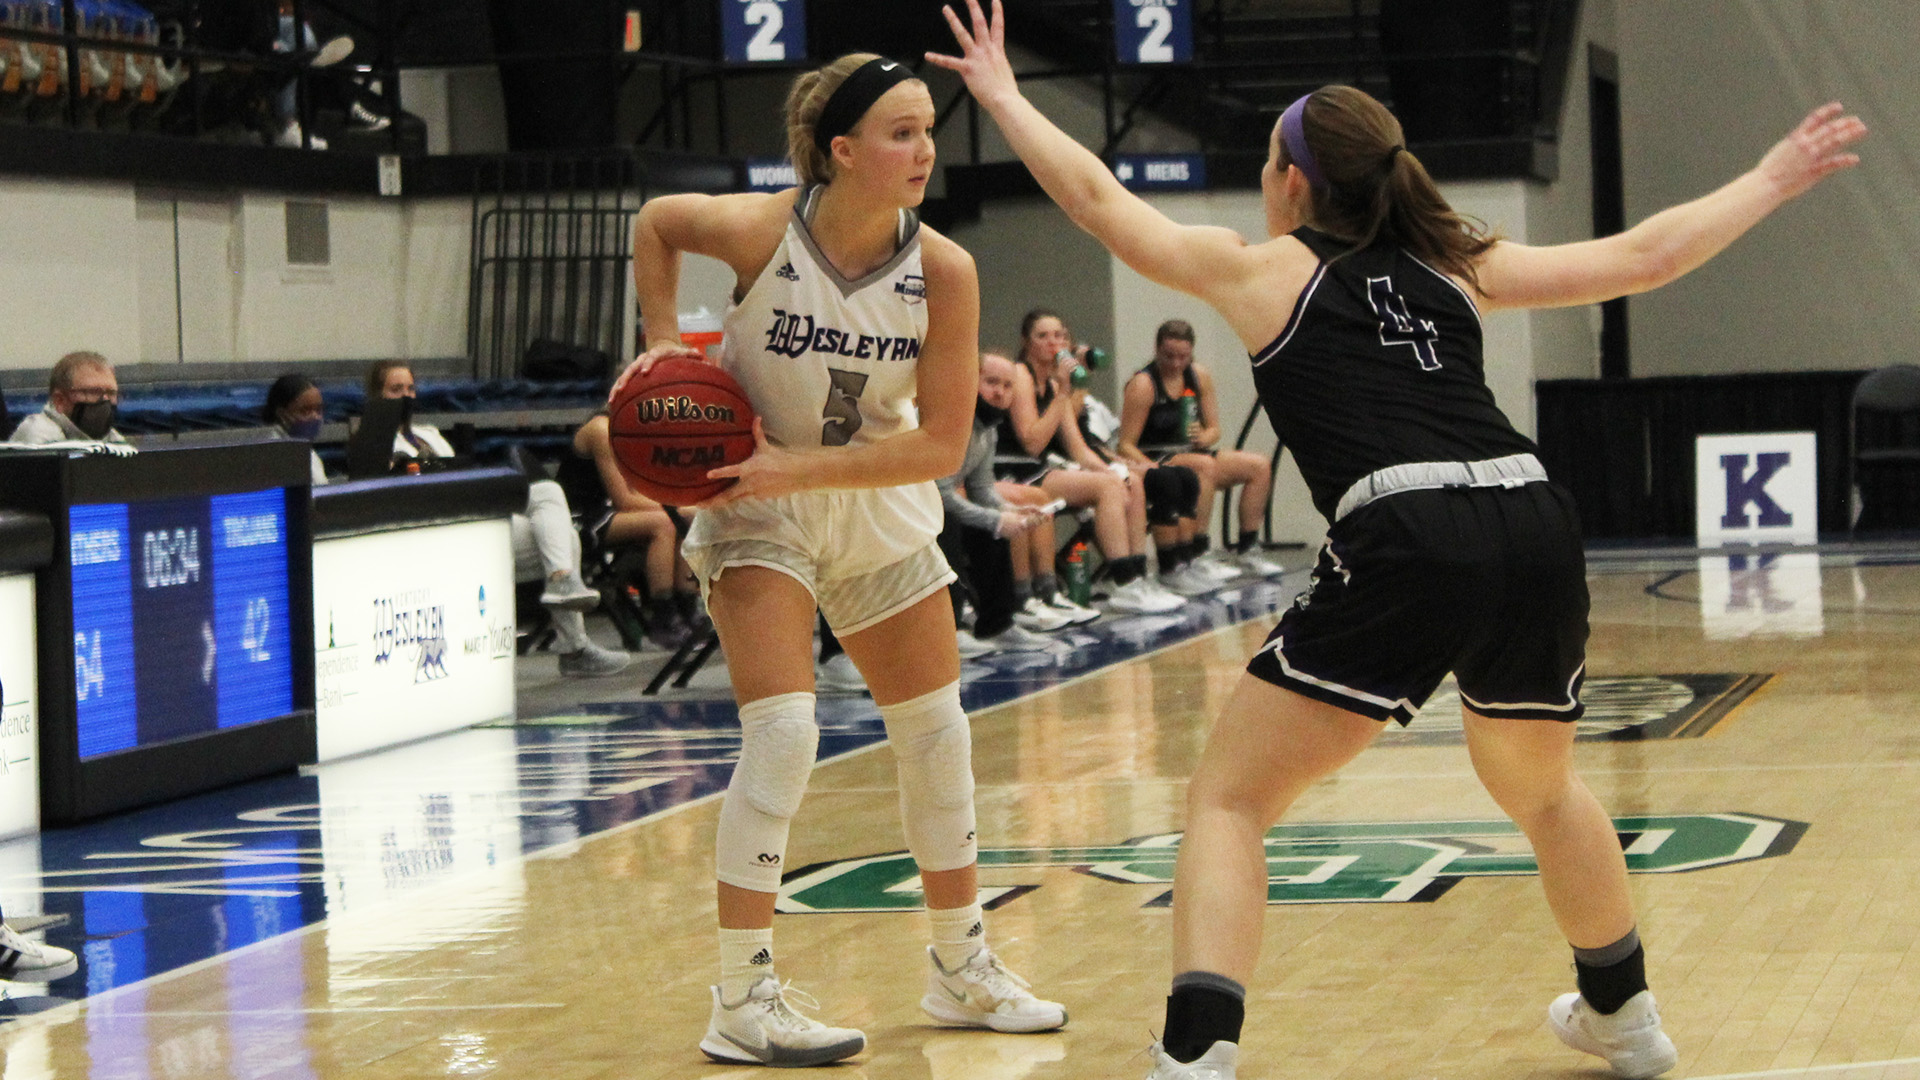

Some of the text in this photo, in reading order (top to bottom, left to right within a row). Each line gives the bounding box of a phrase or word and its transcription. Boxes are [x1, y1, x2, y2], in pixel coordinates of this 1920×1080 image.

[744, 2, 785, 61] 2
[1136, 6, 1173, 62] 2
[1145, 162, 1190, 181] MENS
[776, 270, 800, 281] adidas
[1367, 276, 1442, 371] 4
[637, 396, 735, 424] Wilson
[822, 367, 869, 446] 5
[651, 445, 725, 468] NCAA
[1720, 452, 1793, 529] K
[241, 597, 270, 662] 42
[318, 652, 359, 684] ependence
[323, 683, 343, 708] Bank
